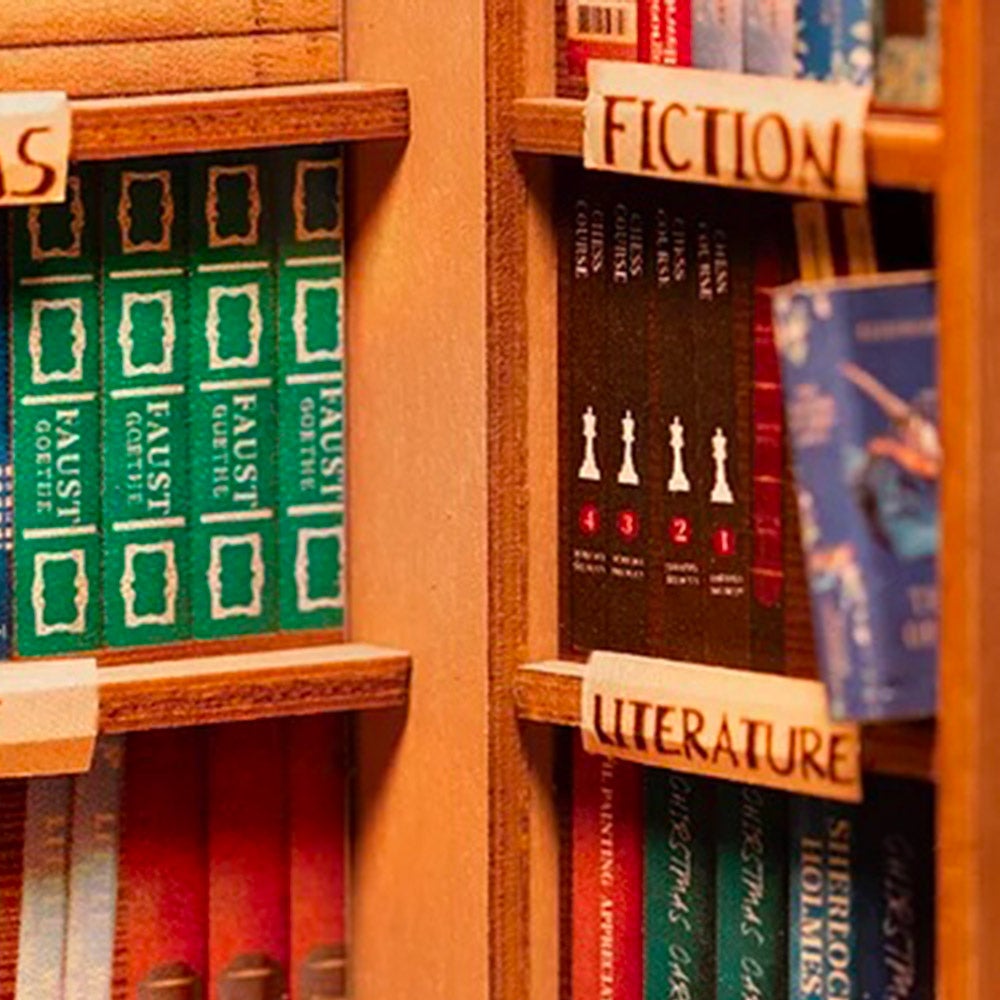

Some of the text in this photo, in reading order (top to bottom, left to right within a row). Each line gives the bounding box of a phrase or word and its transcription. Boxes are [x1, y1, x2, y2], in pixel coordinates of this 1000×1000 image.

[603, 96, 842, 191] FICTION
[56, 408, 82, 526] FAUST
[146, 401, 172, 516] FAUST
[232, 393, 259, 510] FAUST
[320, 387, 343, 496] FAUST
[673, 518, 688, 543] 2
[594, 694, 857, 785] LITERATURE
[600, 786, 615, 887] PAINTING
[801, 836, 824, 996] HOLMES
